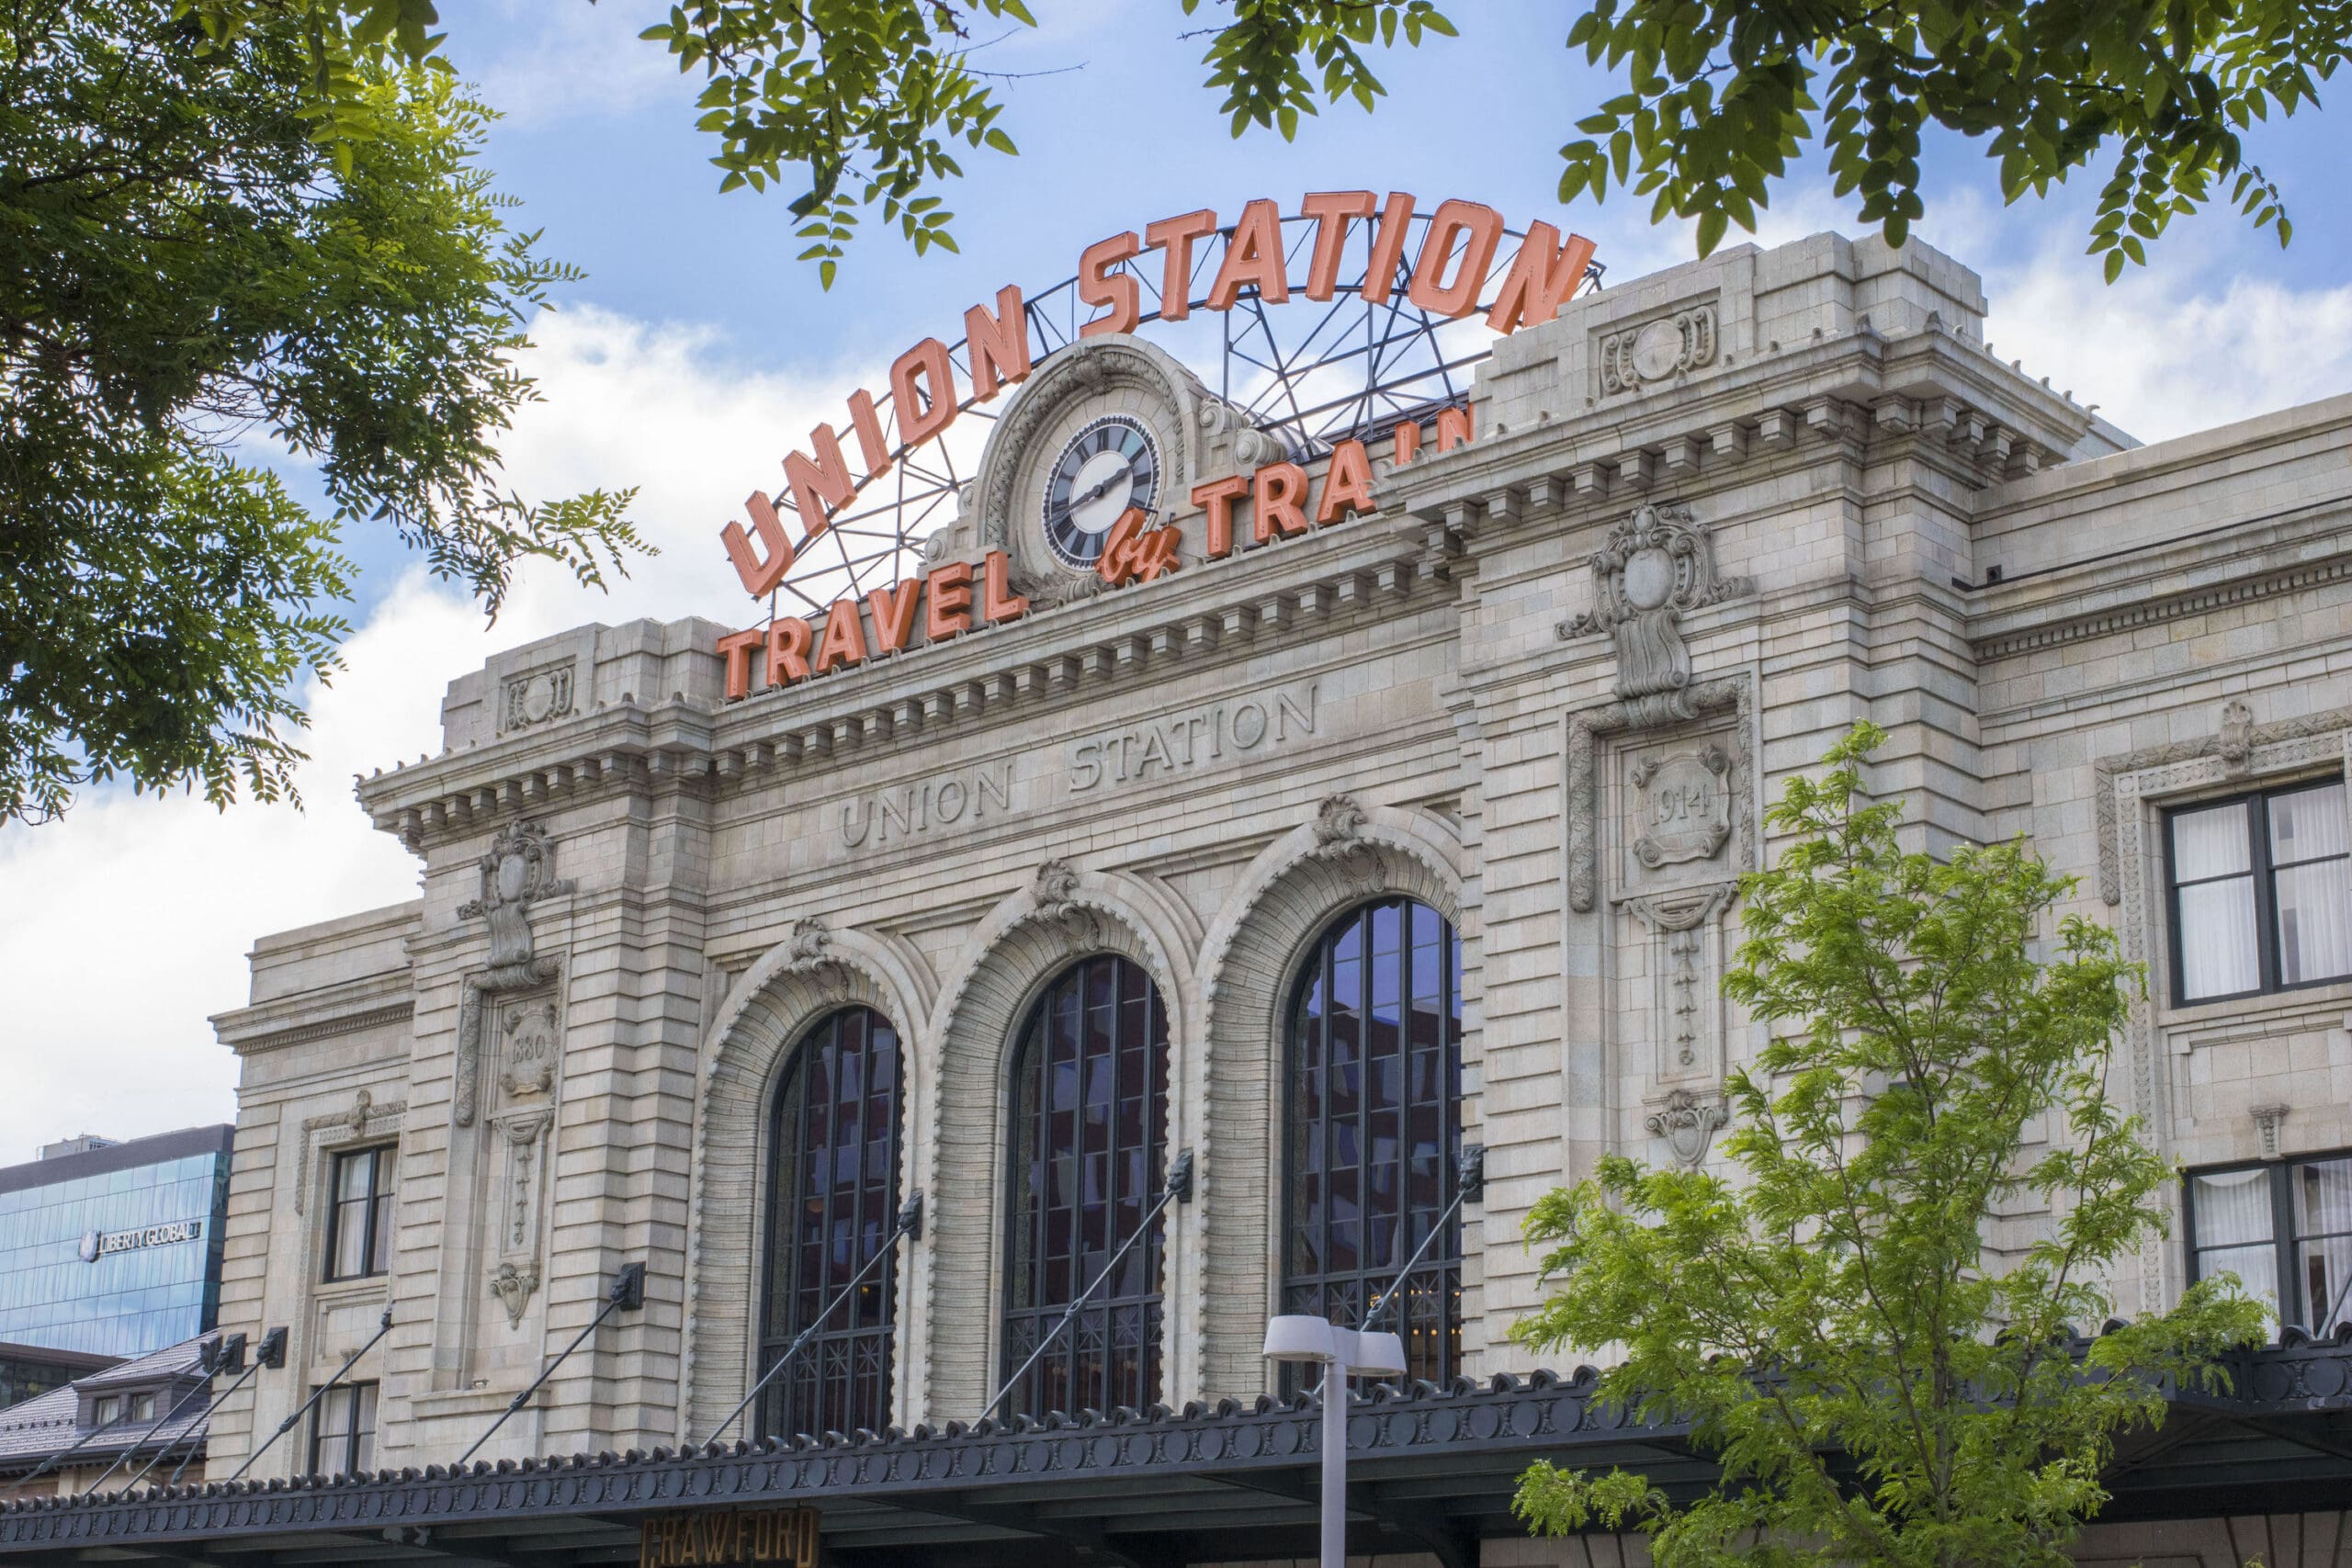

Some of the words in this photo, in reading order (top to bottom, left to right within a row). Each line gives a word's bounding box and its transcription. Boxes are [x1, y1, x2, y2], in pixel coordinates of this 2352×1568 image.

[719, 283, 1033, 601] UNION
[1079, 189, 1599, 337] STATION
[717, 549, 1030, 701] TRAVEL
[1094, 507, 1182, 586] by
[843, 763, 1012, 848] UNION
[1069, 683, 1318, 793] STATION
[1651, 784, 1711, 827] 1914
[97, 1230, 147, 1255] LIBERTY
[640, 1506, 820, 1568] CRAWFORD
